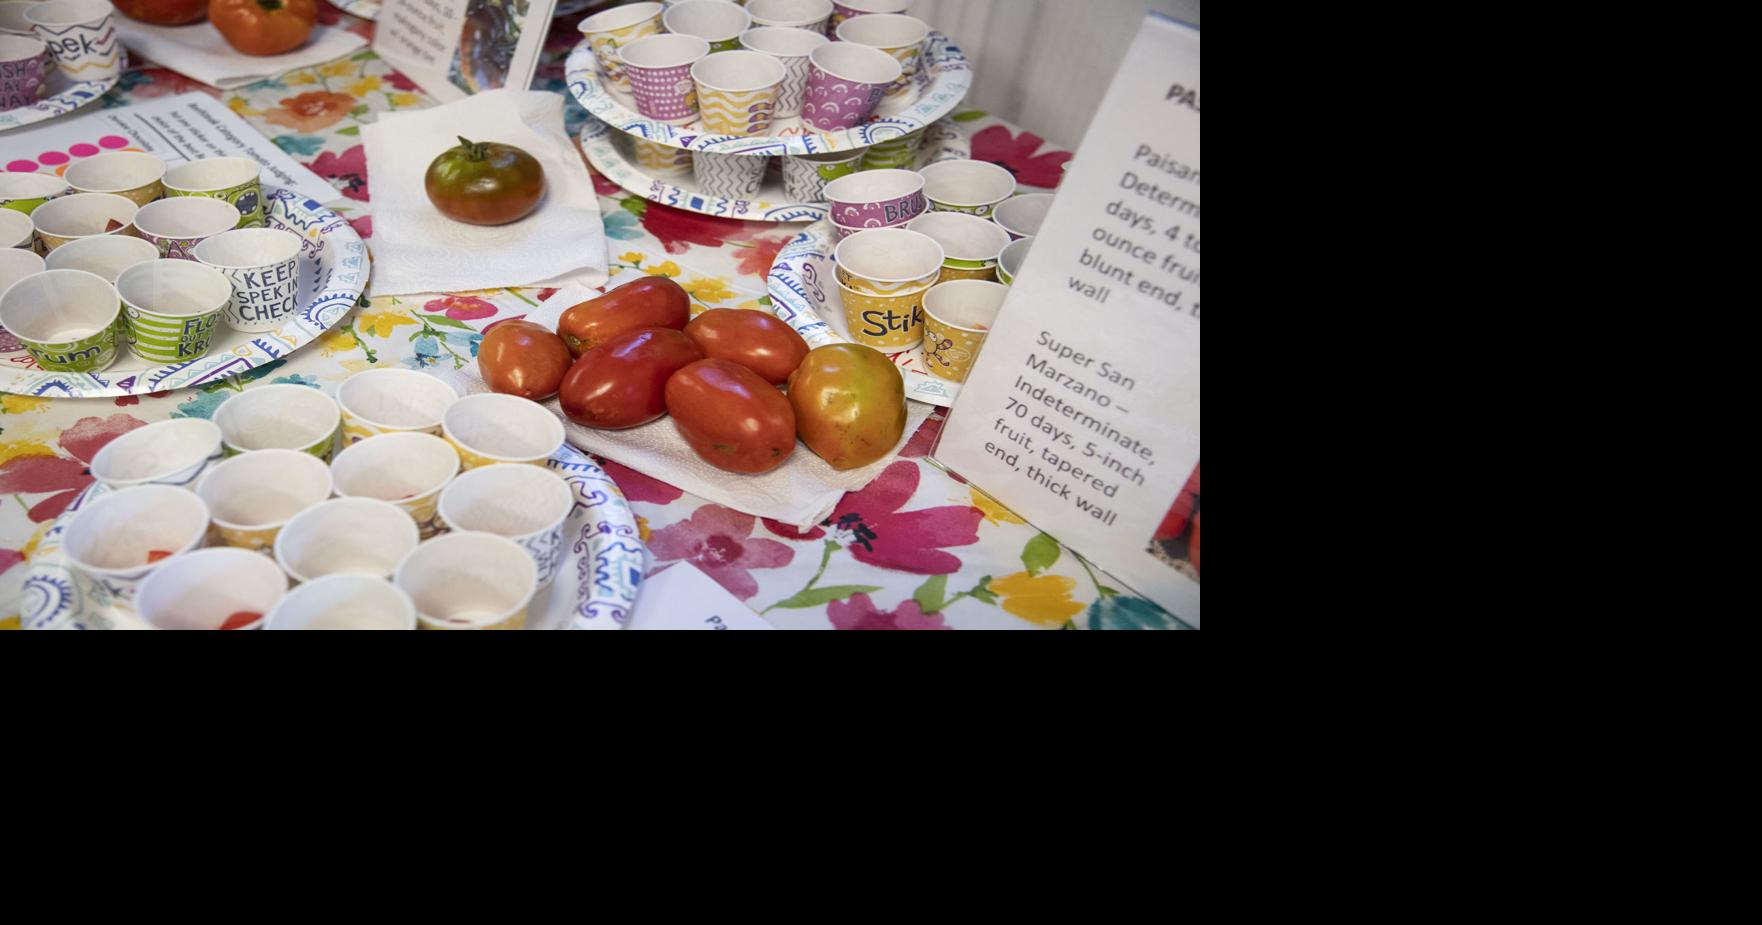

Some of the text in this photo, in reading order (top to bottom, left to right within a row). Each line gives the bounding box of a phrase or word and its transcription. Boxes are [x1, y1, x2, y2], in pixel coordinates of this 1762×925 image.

[47, 33, 97, 61] pek
[1105, 200, 1156, 236] days,
[1164, 224, 1181, 243] 4
[1091, 227, 1157, 265] ounce
[236, 277, 298, 304] SPEK IN
[243, 260, 296, 289] KEEP
[1068, 276, 1111, 304] wall
[1079, 248, 1134, 286] blunt
[1137, 275, 1183, 311] end,
[239, 292, 298, 321] CHECK
[862, 305, 924, 337] Stik
[30, 345, 101, 365] rum
[1036, 330, 1136, 392] Super San
[1025, 353, 1112, 408] Marzano
[1014, 375, 1156, 467] Indeterminate,
[993, 418, 1120, 498] fruit, tapered
[1004, 397, 1146, 487] 70 days, 5-inch
[984, 441, 1118, 527] end, thick wall
